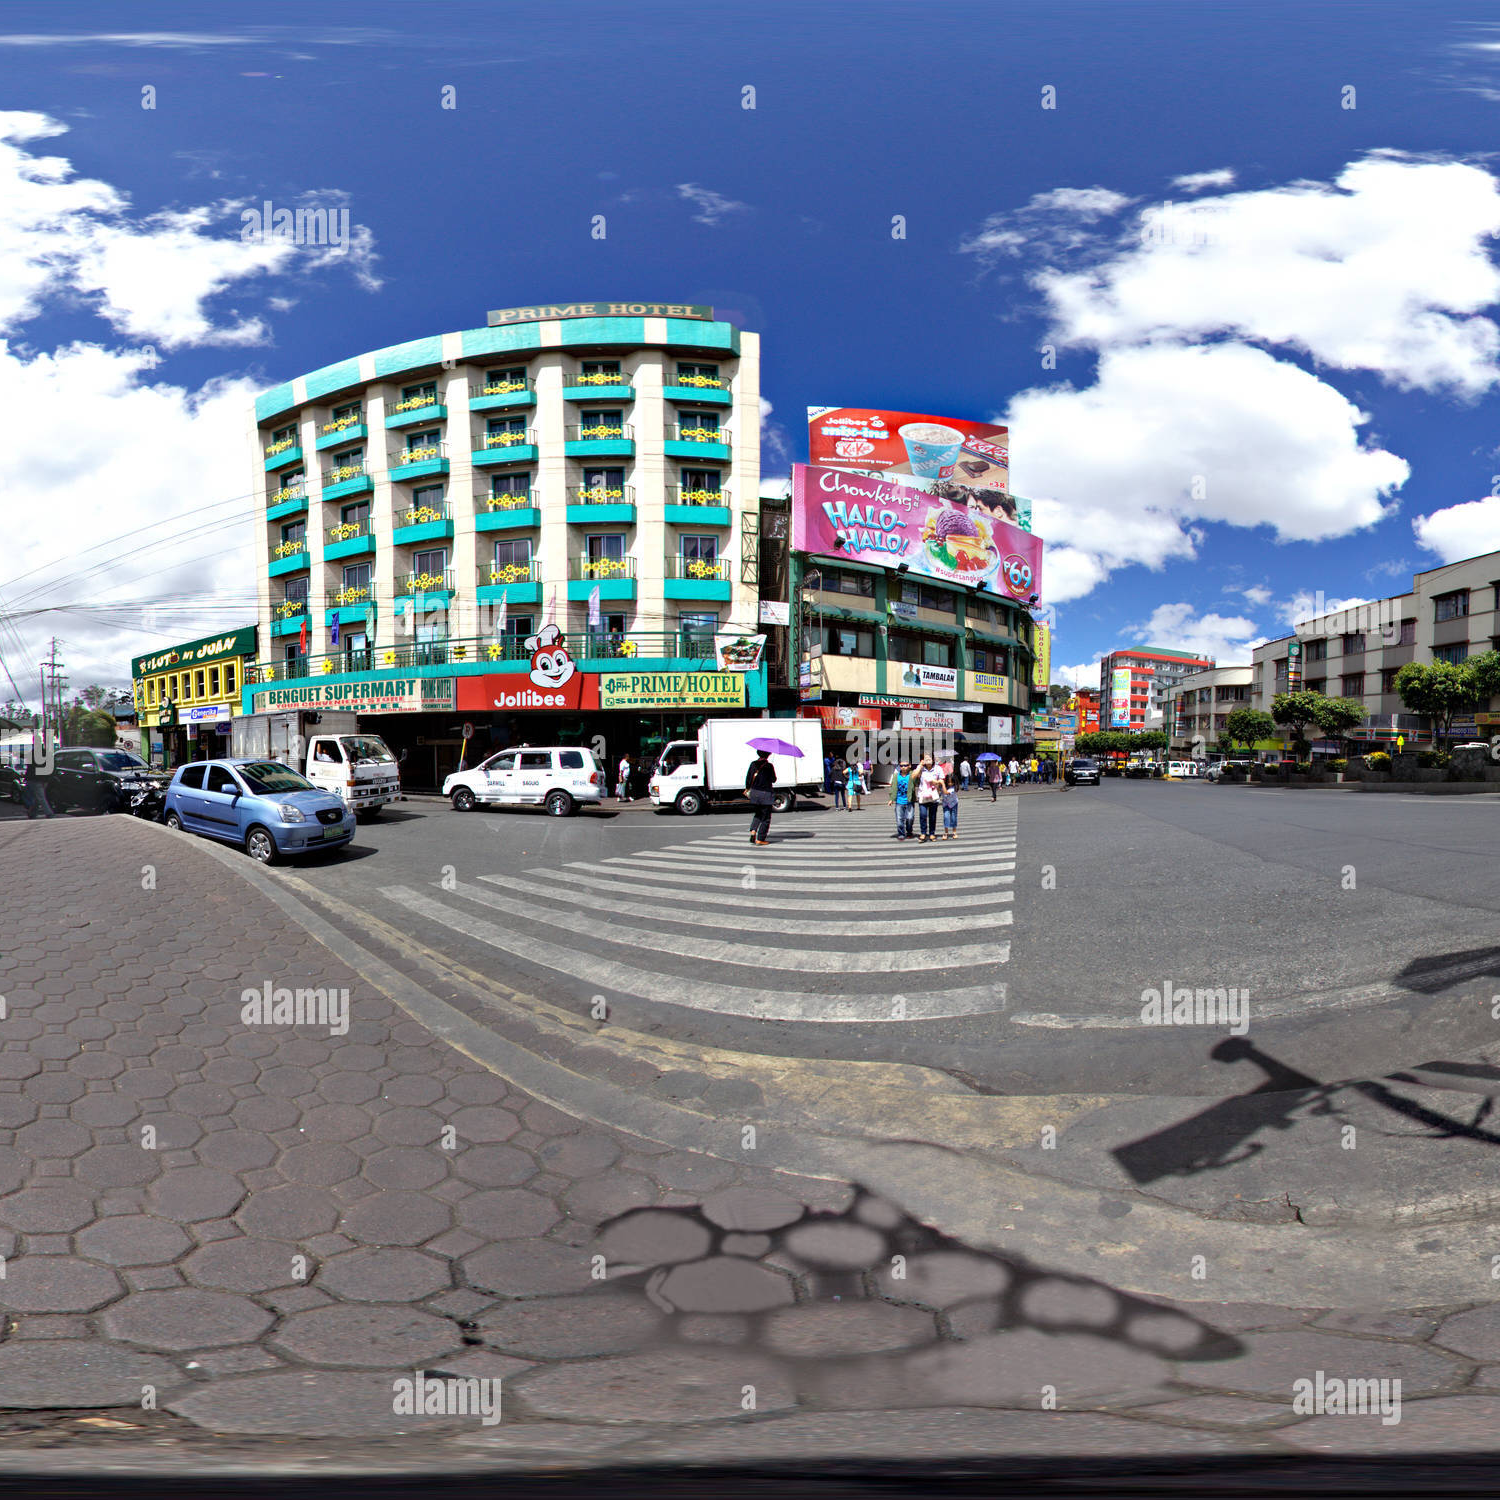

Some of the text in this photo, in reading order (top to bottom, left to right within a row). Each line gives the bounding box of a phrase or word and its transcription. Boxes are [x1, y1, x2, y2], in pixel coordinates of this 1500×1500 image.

[499, 303, 703, 322] PRIME HOTEL
[826, 417, 868, 426] Jollibee
[819, 471, 913, 512] Chowking
[822, 501, 908, 532] HALO-
[836, 528, 910, 556] HALO!
[196, 636, 237, 659] JUAN
[631, 675, 741, 693] PRIME HOTEL
[922, 670, 955, 683] TAMBALAN
[975, 673, 997, 686] SATELLITE
[268, 687, 323, 705] BENGUET
[324, 679, 417, 701] SUPERMART
[367, 695, 405, 704] STORE
[494, 688, 566, 707] Jollibee
